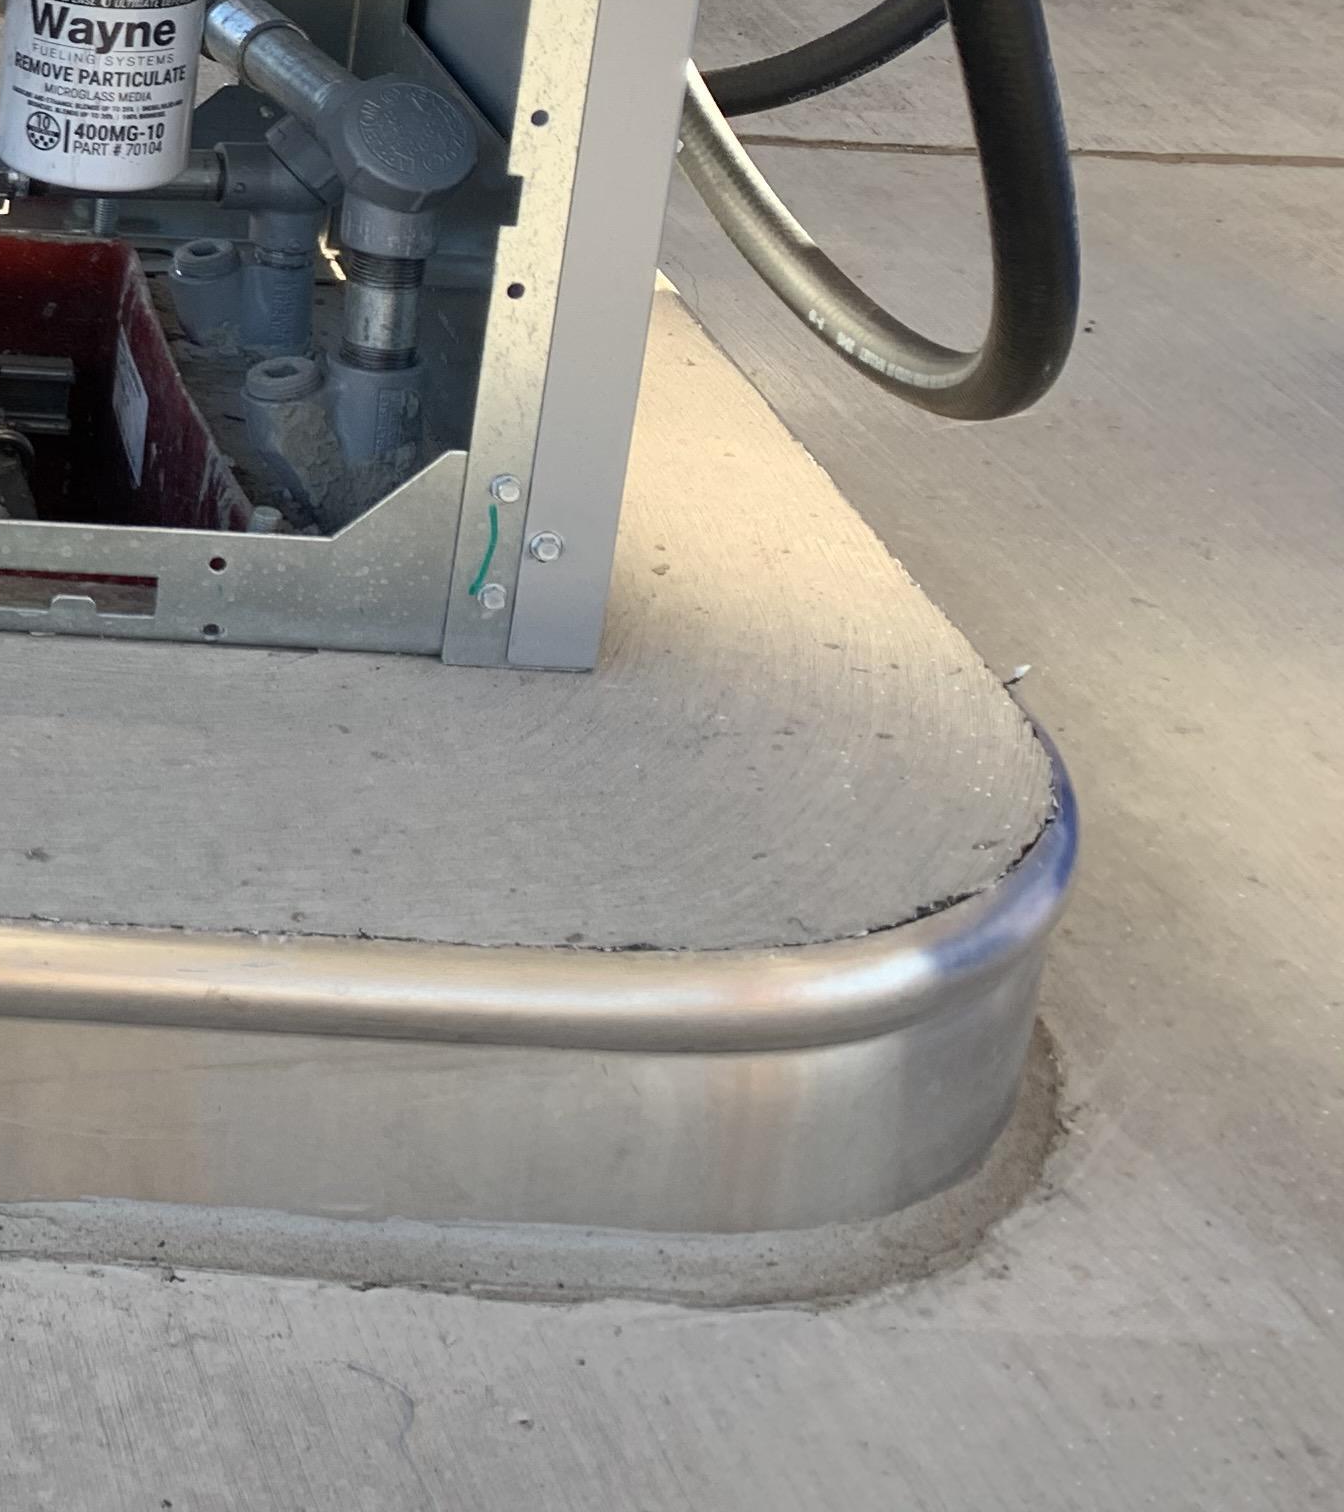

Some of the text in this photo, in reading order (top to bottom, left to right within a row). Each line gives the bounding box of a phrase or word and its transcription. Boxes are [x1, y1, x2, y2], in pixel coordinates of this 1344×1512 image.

[33, 43, 175, 66] FUELING SYSTEMS
[15, 51, 187, 88] REMOVE PARTICULATE
[44, 83, 152, 102] MICROGLASS MEDIA
[37, 114, 51, 130] 10
[74, 123, 165, 141] 400MG-10
[73, 140, 162, 156] PART # 70104
